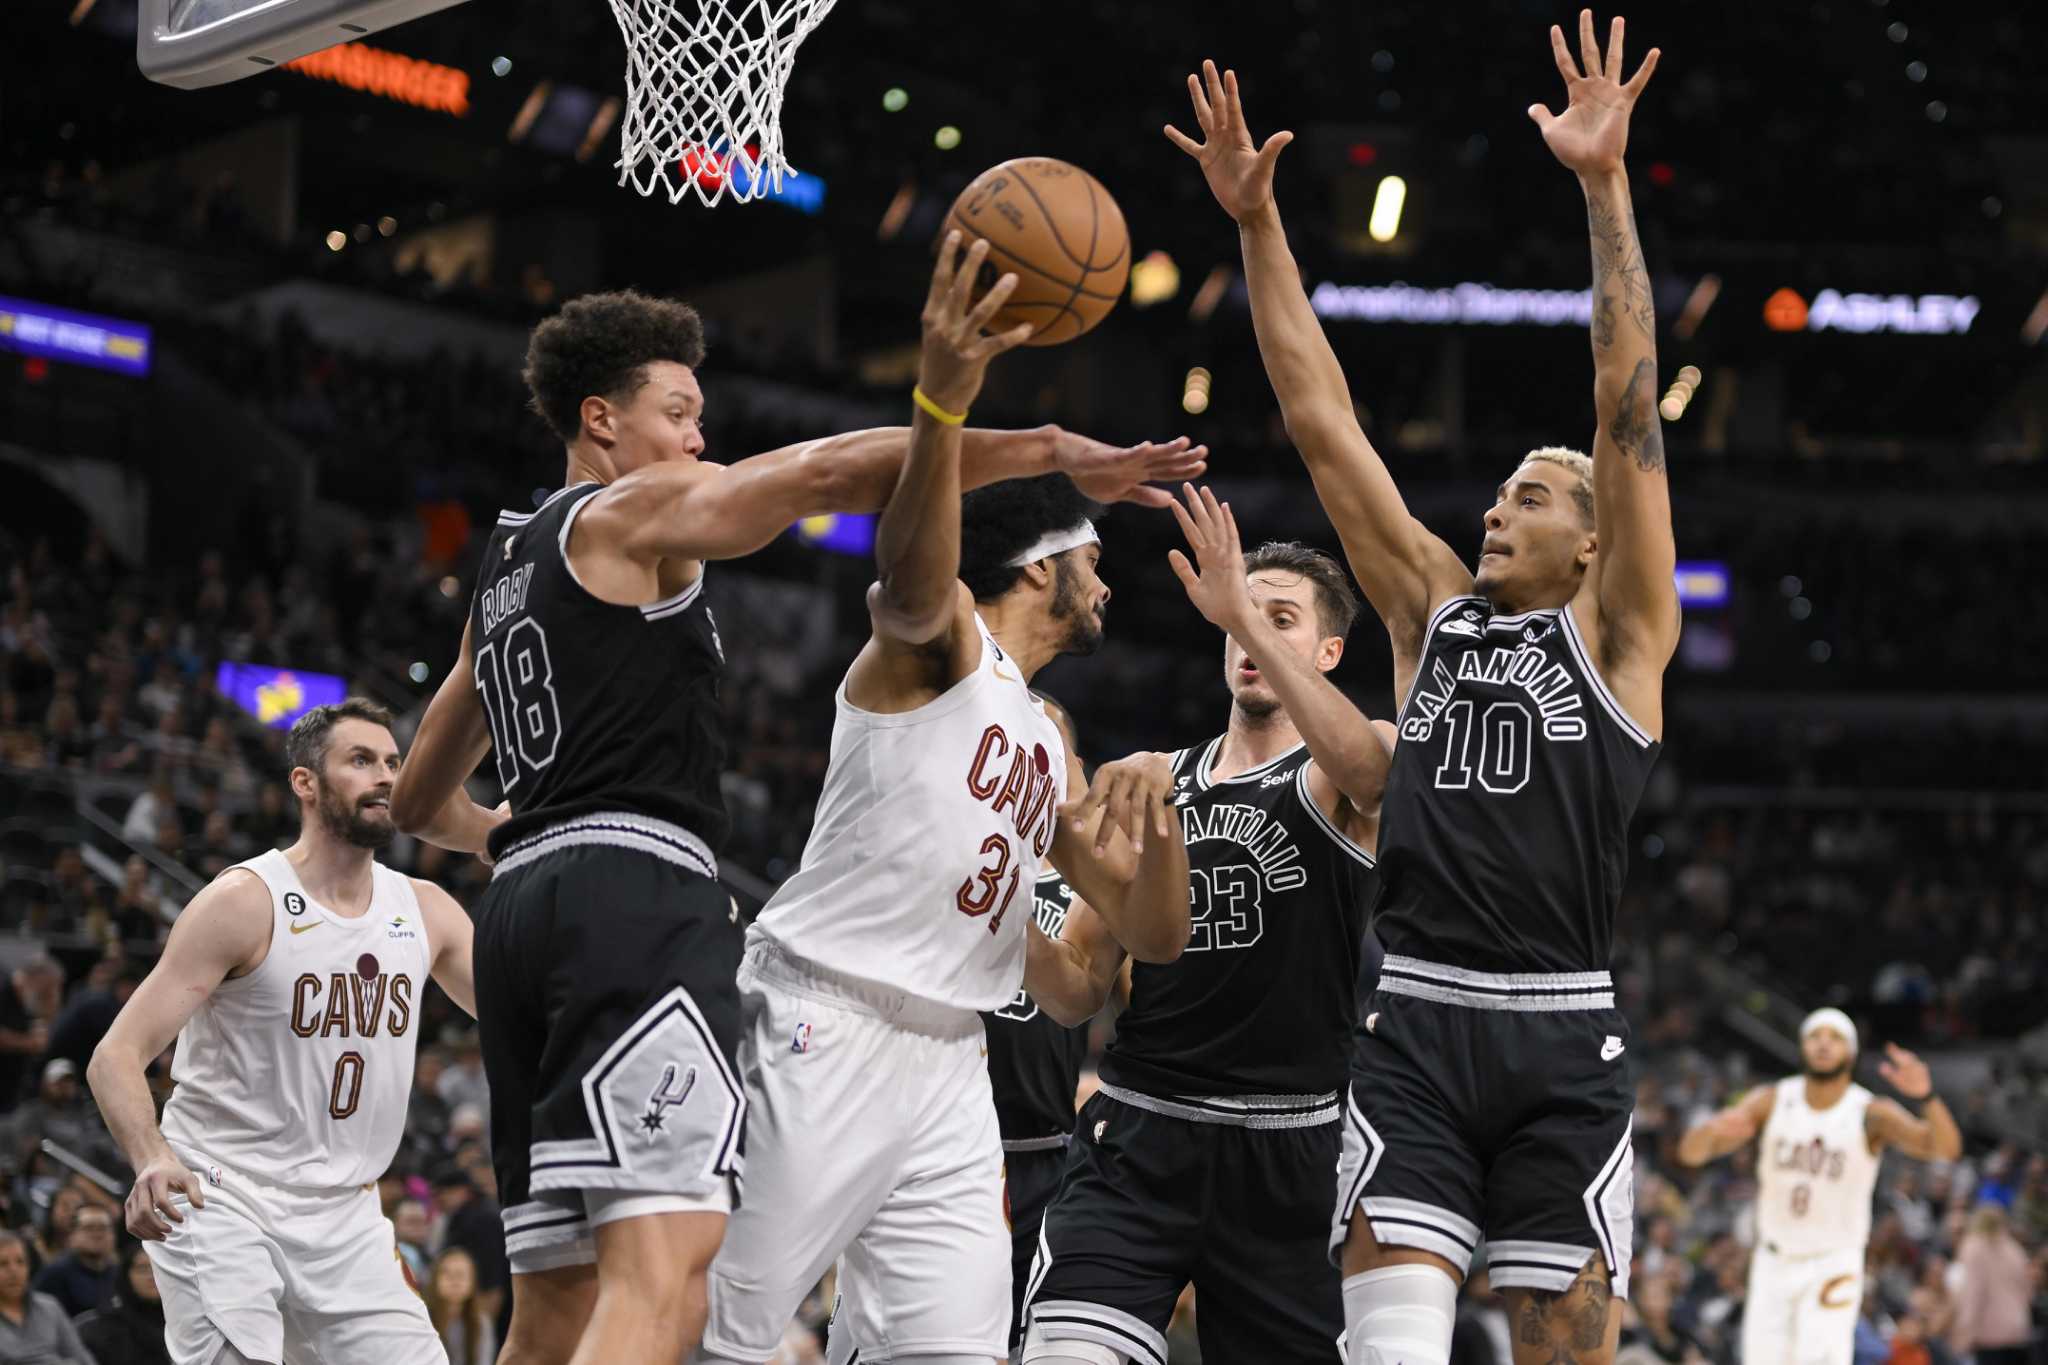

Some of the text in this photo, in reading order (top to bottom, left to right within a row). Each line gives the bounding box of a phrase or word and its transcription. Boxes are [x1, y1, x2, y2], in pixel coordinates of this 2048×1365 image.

[1808, 289, 1981, 333] ASHLEY
[481, 562, 535, 636] ROBY
[474, 616, 562, 794] 18
[1401, 656, 1457, 742] SAN
[1434, 700, 1532, 794] 10
[966, 723, 1057, 858] CAVS
[956, 832, 1020, 935] 31
[1183, 804, 1307, 892] ANTONIO
[287, 895, 303, 914] 6
[290, 972, 412, 1038] CAVS
[329, 1051, 365, 1121] 0
